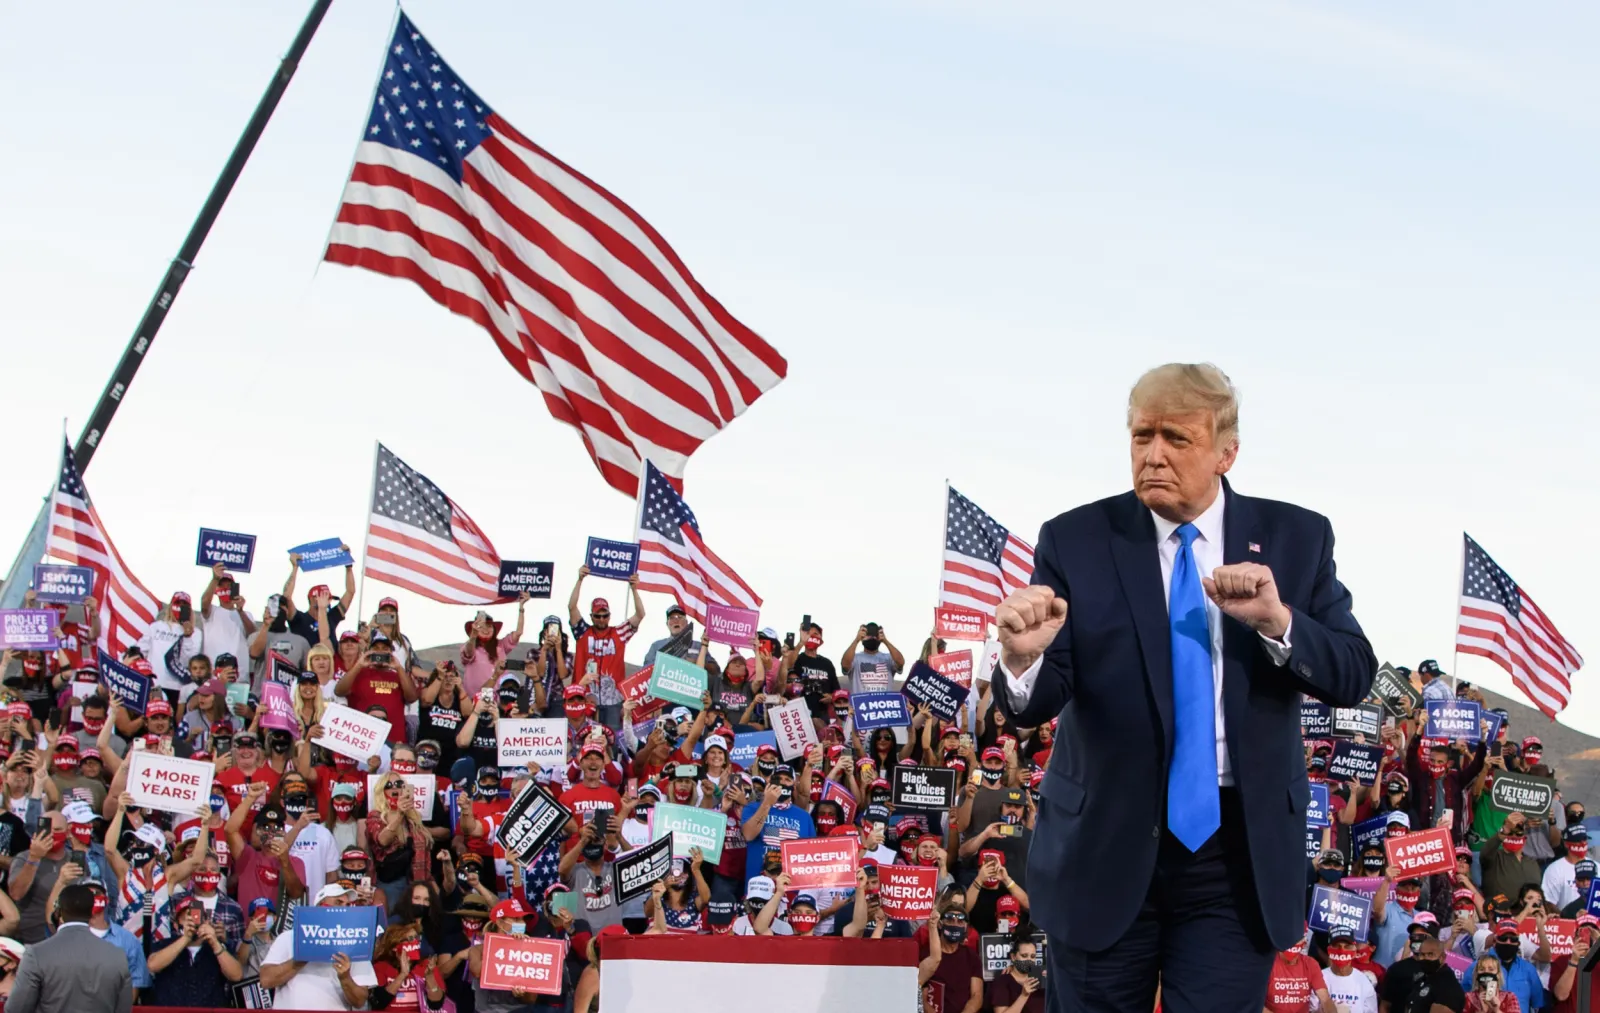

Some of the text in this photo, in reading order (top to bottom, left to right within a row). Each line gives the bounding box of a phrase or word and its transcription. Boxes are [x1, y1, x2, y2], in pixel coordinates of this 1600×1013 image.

[205, 539, 248, 553] 4 MORE
[206, 550, 245, 564] YEARS!
[592, 547, 632, 561] 4 MORE
[517, 566, 538, 574] MAKE
[592, 558, 630, 572] YEARS!
[42, 572, 85, 584] YEARS!
[502, 574, 551, 584] AMERICA
[41, 583, 86, 595] 4 MORE
[502, 584, 526, 592] GREAT
[4, 614, 47, 625] PRO-LIFE
[711, 613, 751, 632] Women
[942, 613, 981, 624] 4 MORE
[4, 624, 37, 634] VOICES
[714, 626, 746, 637] FOR TRUMP
[942, 622, 980, 633] YEARS!
[939, 660, 971, 673] 4 MORE
[109, 668, 142, 692] MORE
[661, 663, 703, 688] Latinos
[928, 674, 951, 693] MAKE
[631, 687, 638, 697] 4
[910, 675, 958, 707] AMERICA
[859, 700, 901, 712] 4 MORE
[906, 683, 955, 717] GREAT AGAIN
[861, 709, 902, 721] YEARS!
[1336, 708, 1363, 721] COPS
[1432, 709, 1475, 719] 4 MORE
[332, 717, 377, 740] 4 MORE
[432, 717, 457, 730] 2020
[780, 711, 798, 750] 4 MORE
[793, 708, 808, 746] YEARS!
[1355, 723, 1377, 732] TRUMP
[1434, 720, 1474, 731] YEARS!
[520, 727, 546, 735] MAKE
[328, 728, 371, 752] YEARS!
[502, 737, 563, 747] AMERICA
[1349, 749, 1370, 759] MAKE
[1333, 756, 1378, 771] AMERICA
[142, 768, 200, 786] 4 MORE
[902, 772, 928, 784] Black
[1330, 766, 1354, 777] GREAT
[142, 783, 196, 800] YEARS!
[916, 784, 945, 795] Voices
[1501, 785, 1547, 802] VETERANS
[573, 801, 614, 809] TRUMP
[1504, 796, 1541, 807] FOR TRUMP
[663, 815, 717, 837] Latinos
[765, 815, 800, 827] JESUS
[505, 815, 533, 848] COPS
[518, 809, 557, 853] FOR TRUMP
[1357, 827, 1388, 841] PEACEF
[1396, 839, 1444, 857] 4 MORE
[790, 852, 851, 864] PEACEFUL
[1399, 852, 1445, 870] YEARS!
[621, 860, 652, 882] COPS
[791, 864, 851, 875] PROTESTER
[623, 877, 642, 892] FOR
[645, 862, 670, 883] TRUMP
[891, 875, 919, 885] MAKE
[882, 885, 933, 899] AMERICA
[587, 894, 611, 909] 2020
[905, 901, 932, 910] AGAIN
[1320, 899, 1363, 918] 4 MORE
[1319, 911, 1360, 930] YEARS!
[301, 924, 368, 938] Workers
[495, 948, 553, 965] 4 MORE
[986, 944, 1011, 958] COP
[495, 963, 549, 980] YEARS!
[1331, 993, 1359, 1001] RUMP
